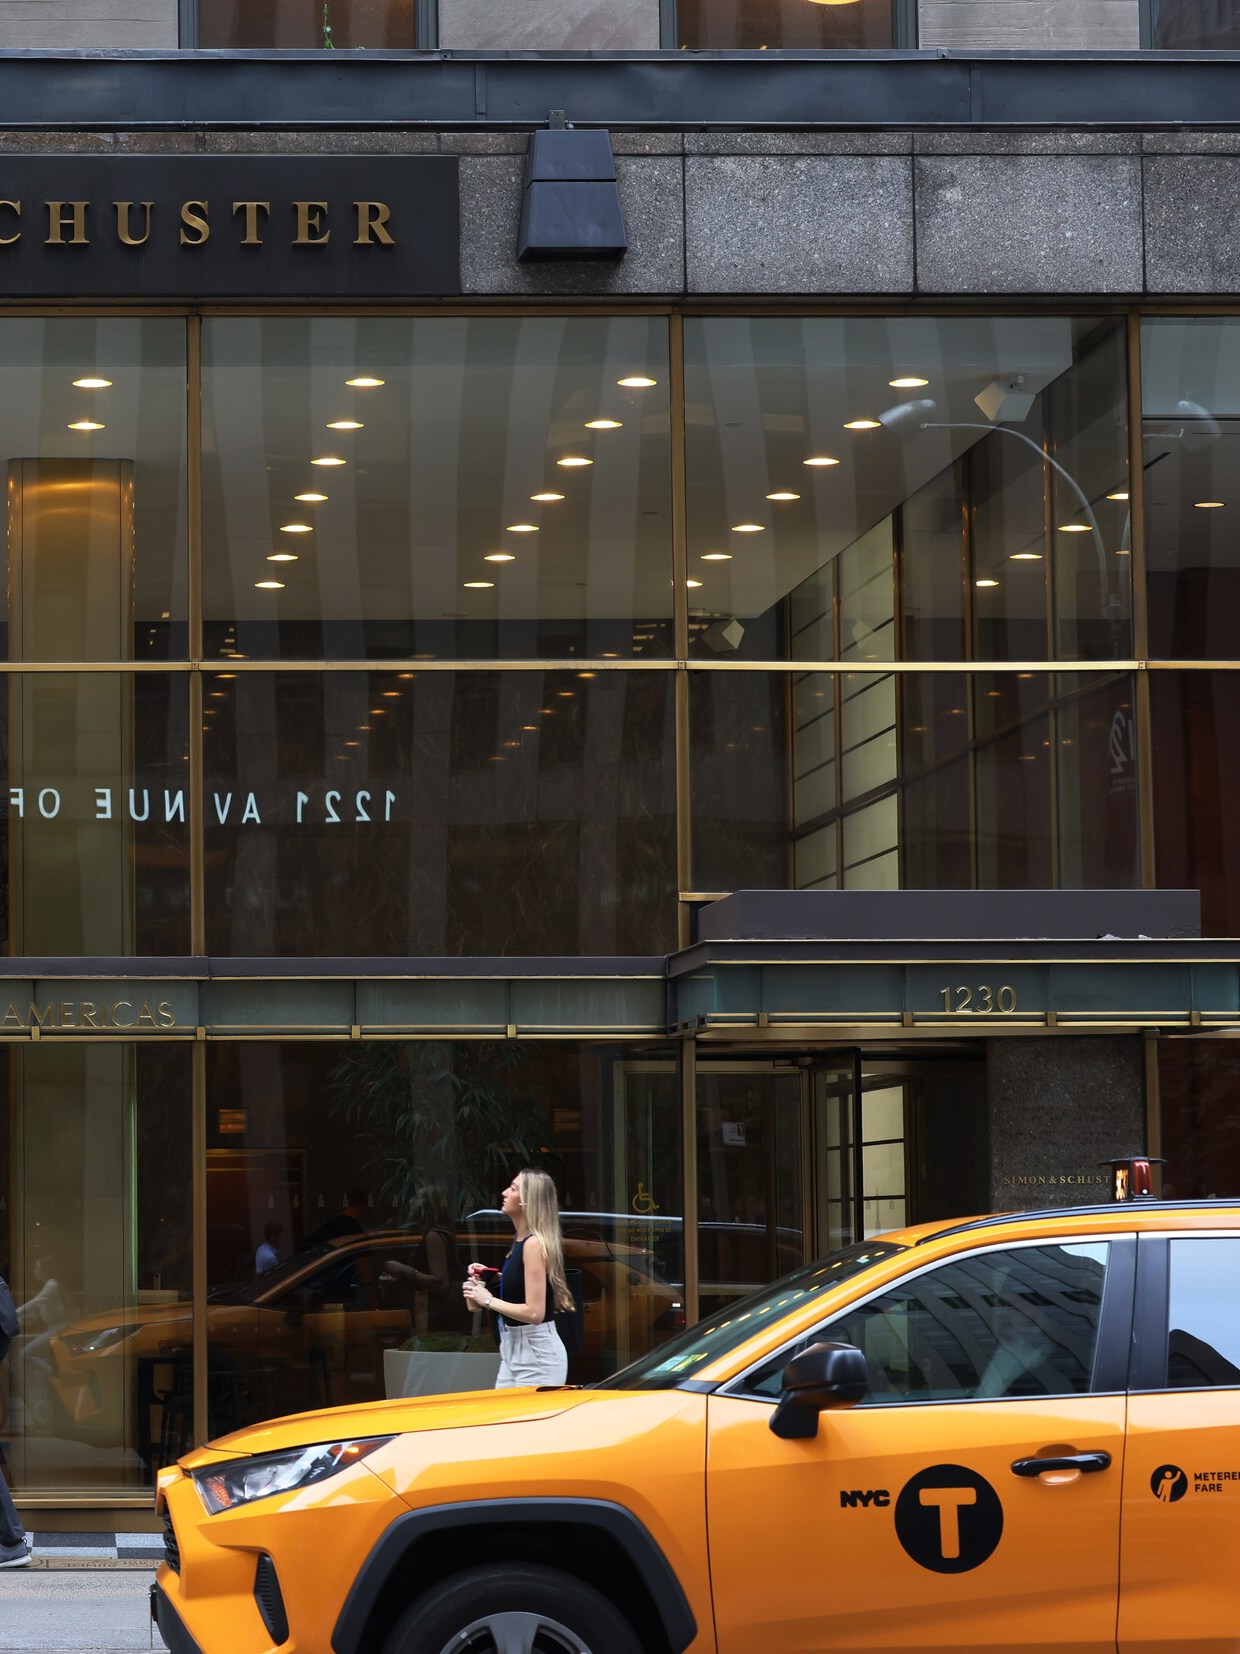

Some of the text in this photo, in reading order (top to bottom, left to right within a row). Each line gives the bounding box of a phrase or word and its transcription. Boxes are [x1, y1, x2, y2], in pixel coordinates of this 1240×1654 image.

[940, 985, 1017, 1013] 1230
[1, 1001, 177, 1027] AMERICAS
[1004, 1175, 1111, 1184] SIMON & SCHUST
[840, 1490, 890, 1507] NYC
[1195, 1484, 1223, 1492] FARE
[919, 1487, 977, 1559] T
